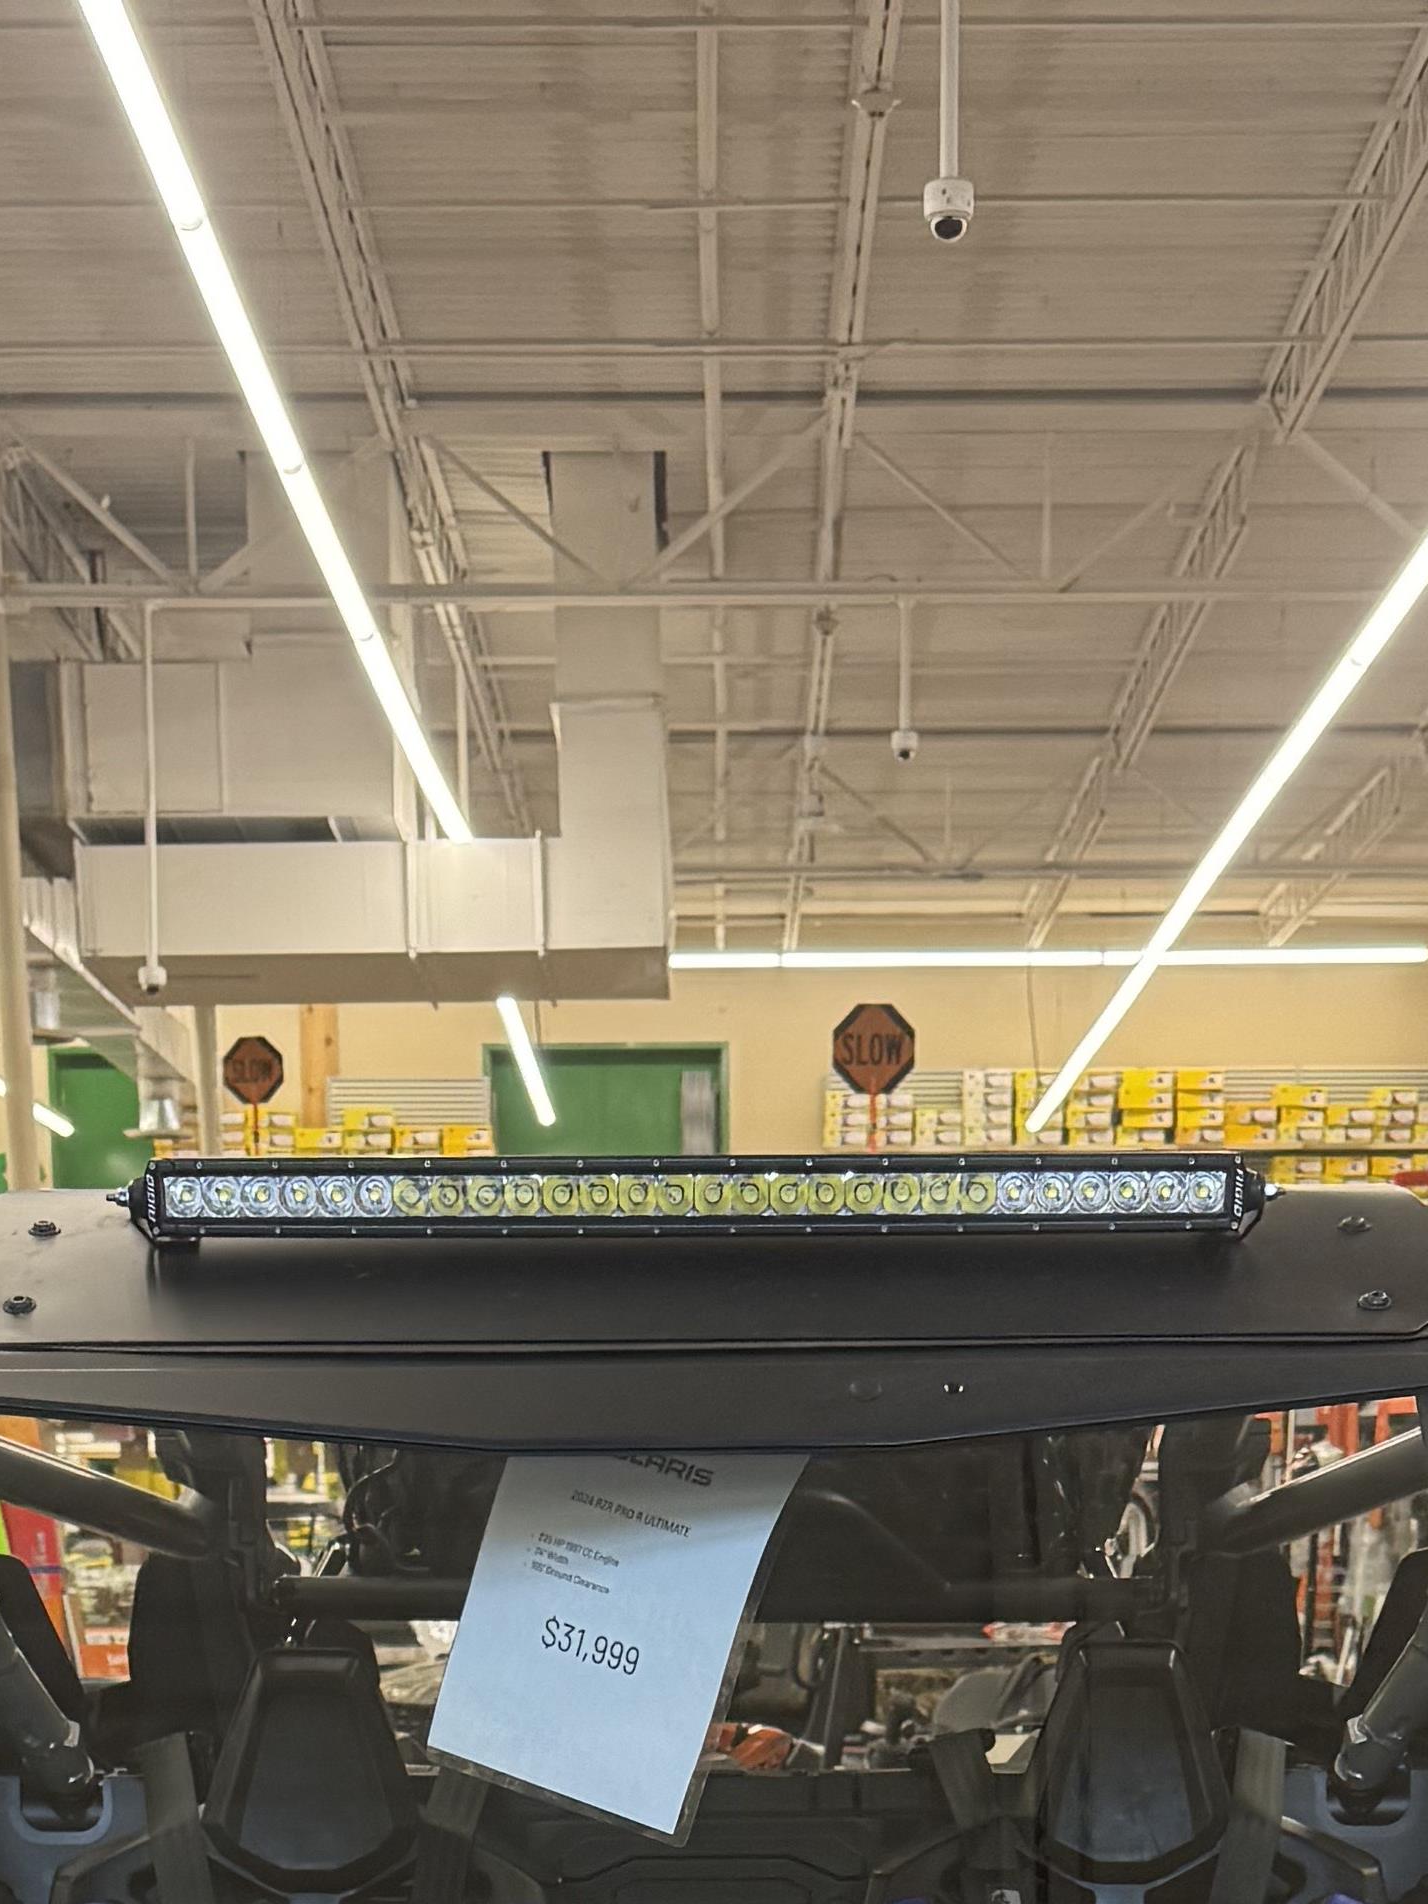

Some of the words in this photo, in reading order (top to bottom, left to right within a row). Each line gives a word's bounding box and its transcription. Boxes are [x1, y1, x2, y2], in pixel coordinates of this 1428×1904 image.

[841, 1032, 903, 1066] SLOW
[644, 1514, 693, 1539] ULTIMATE
[541, 1615, 640, 1676] $31,999
